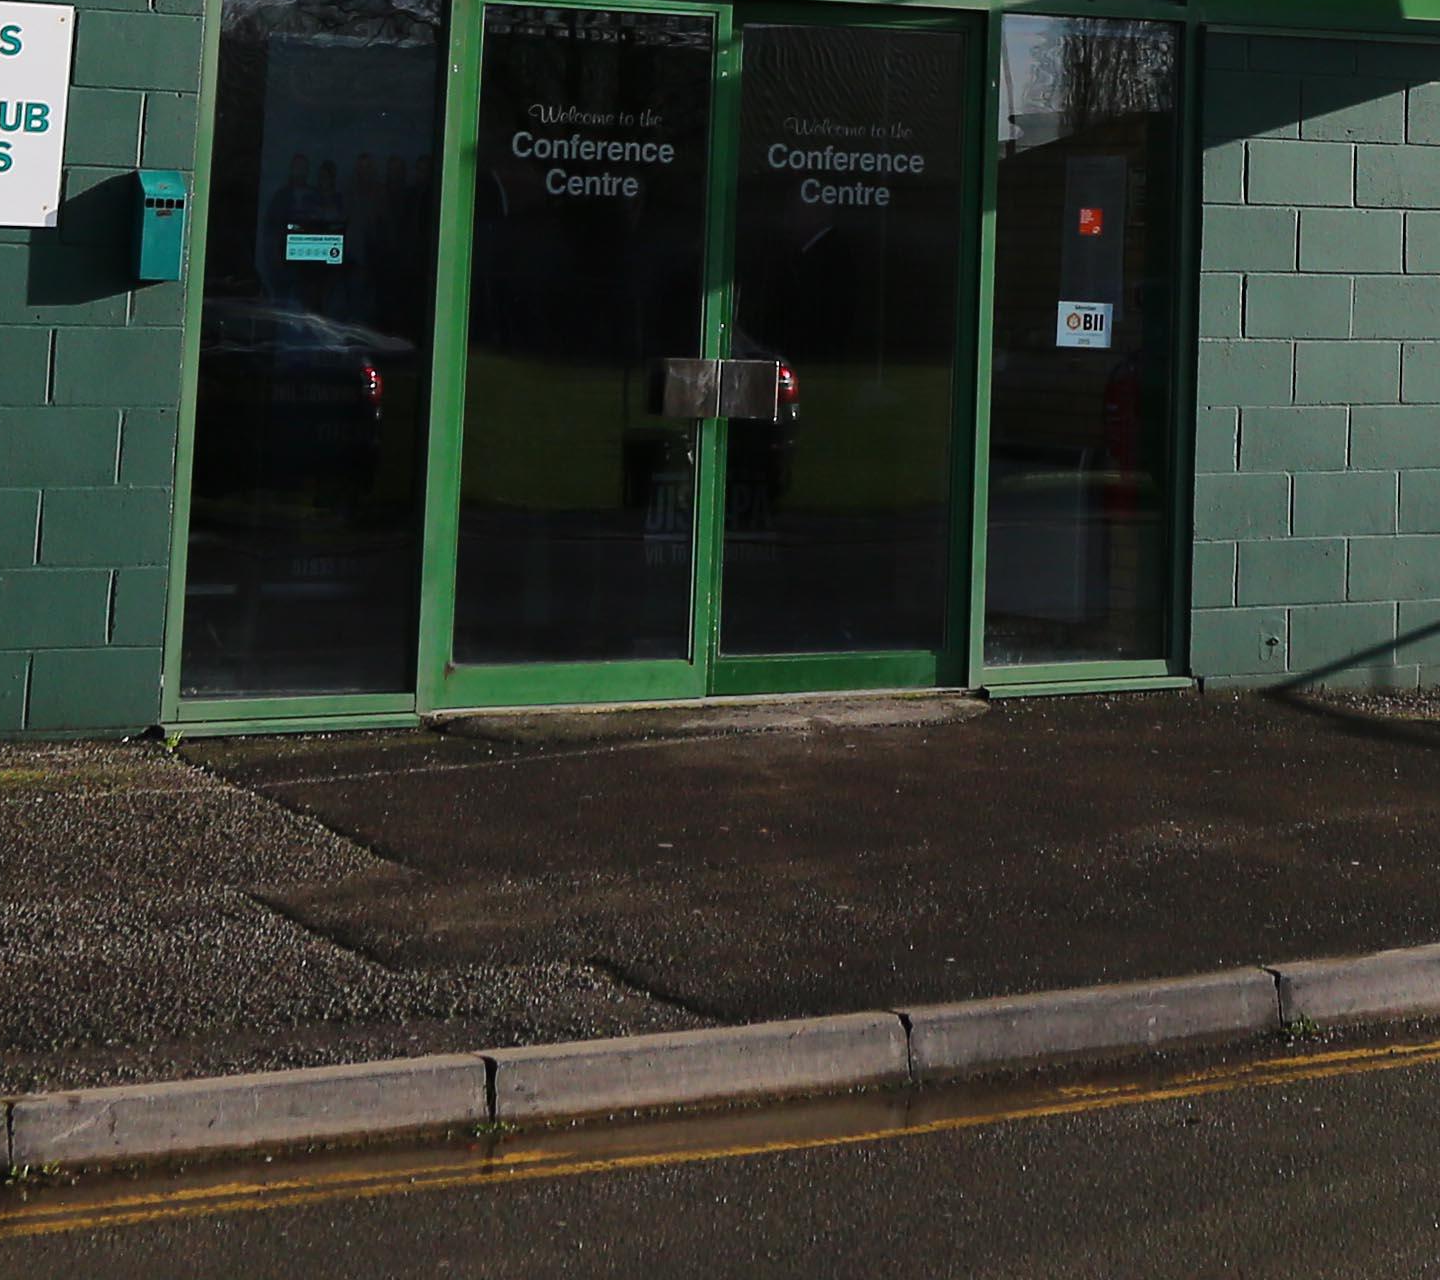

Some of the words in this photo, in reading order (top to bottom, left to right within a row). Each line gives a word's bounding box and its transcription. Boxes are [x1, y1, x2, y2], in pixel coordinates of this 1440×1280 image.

[528, 103, 614, 125] Welcome
[619, 111, 635, 126] to
[640, 108, 663, 127] the
[871, 123, 886, 138] to
[511, 131, 675, 164] Conference
[767, 143, 925, 173] Conference
[545, 168, 640, 197] Centre
[800, 178, 890, 206] Centre
[1083, 313, 1104, 331] BII
